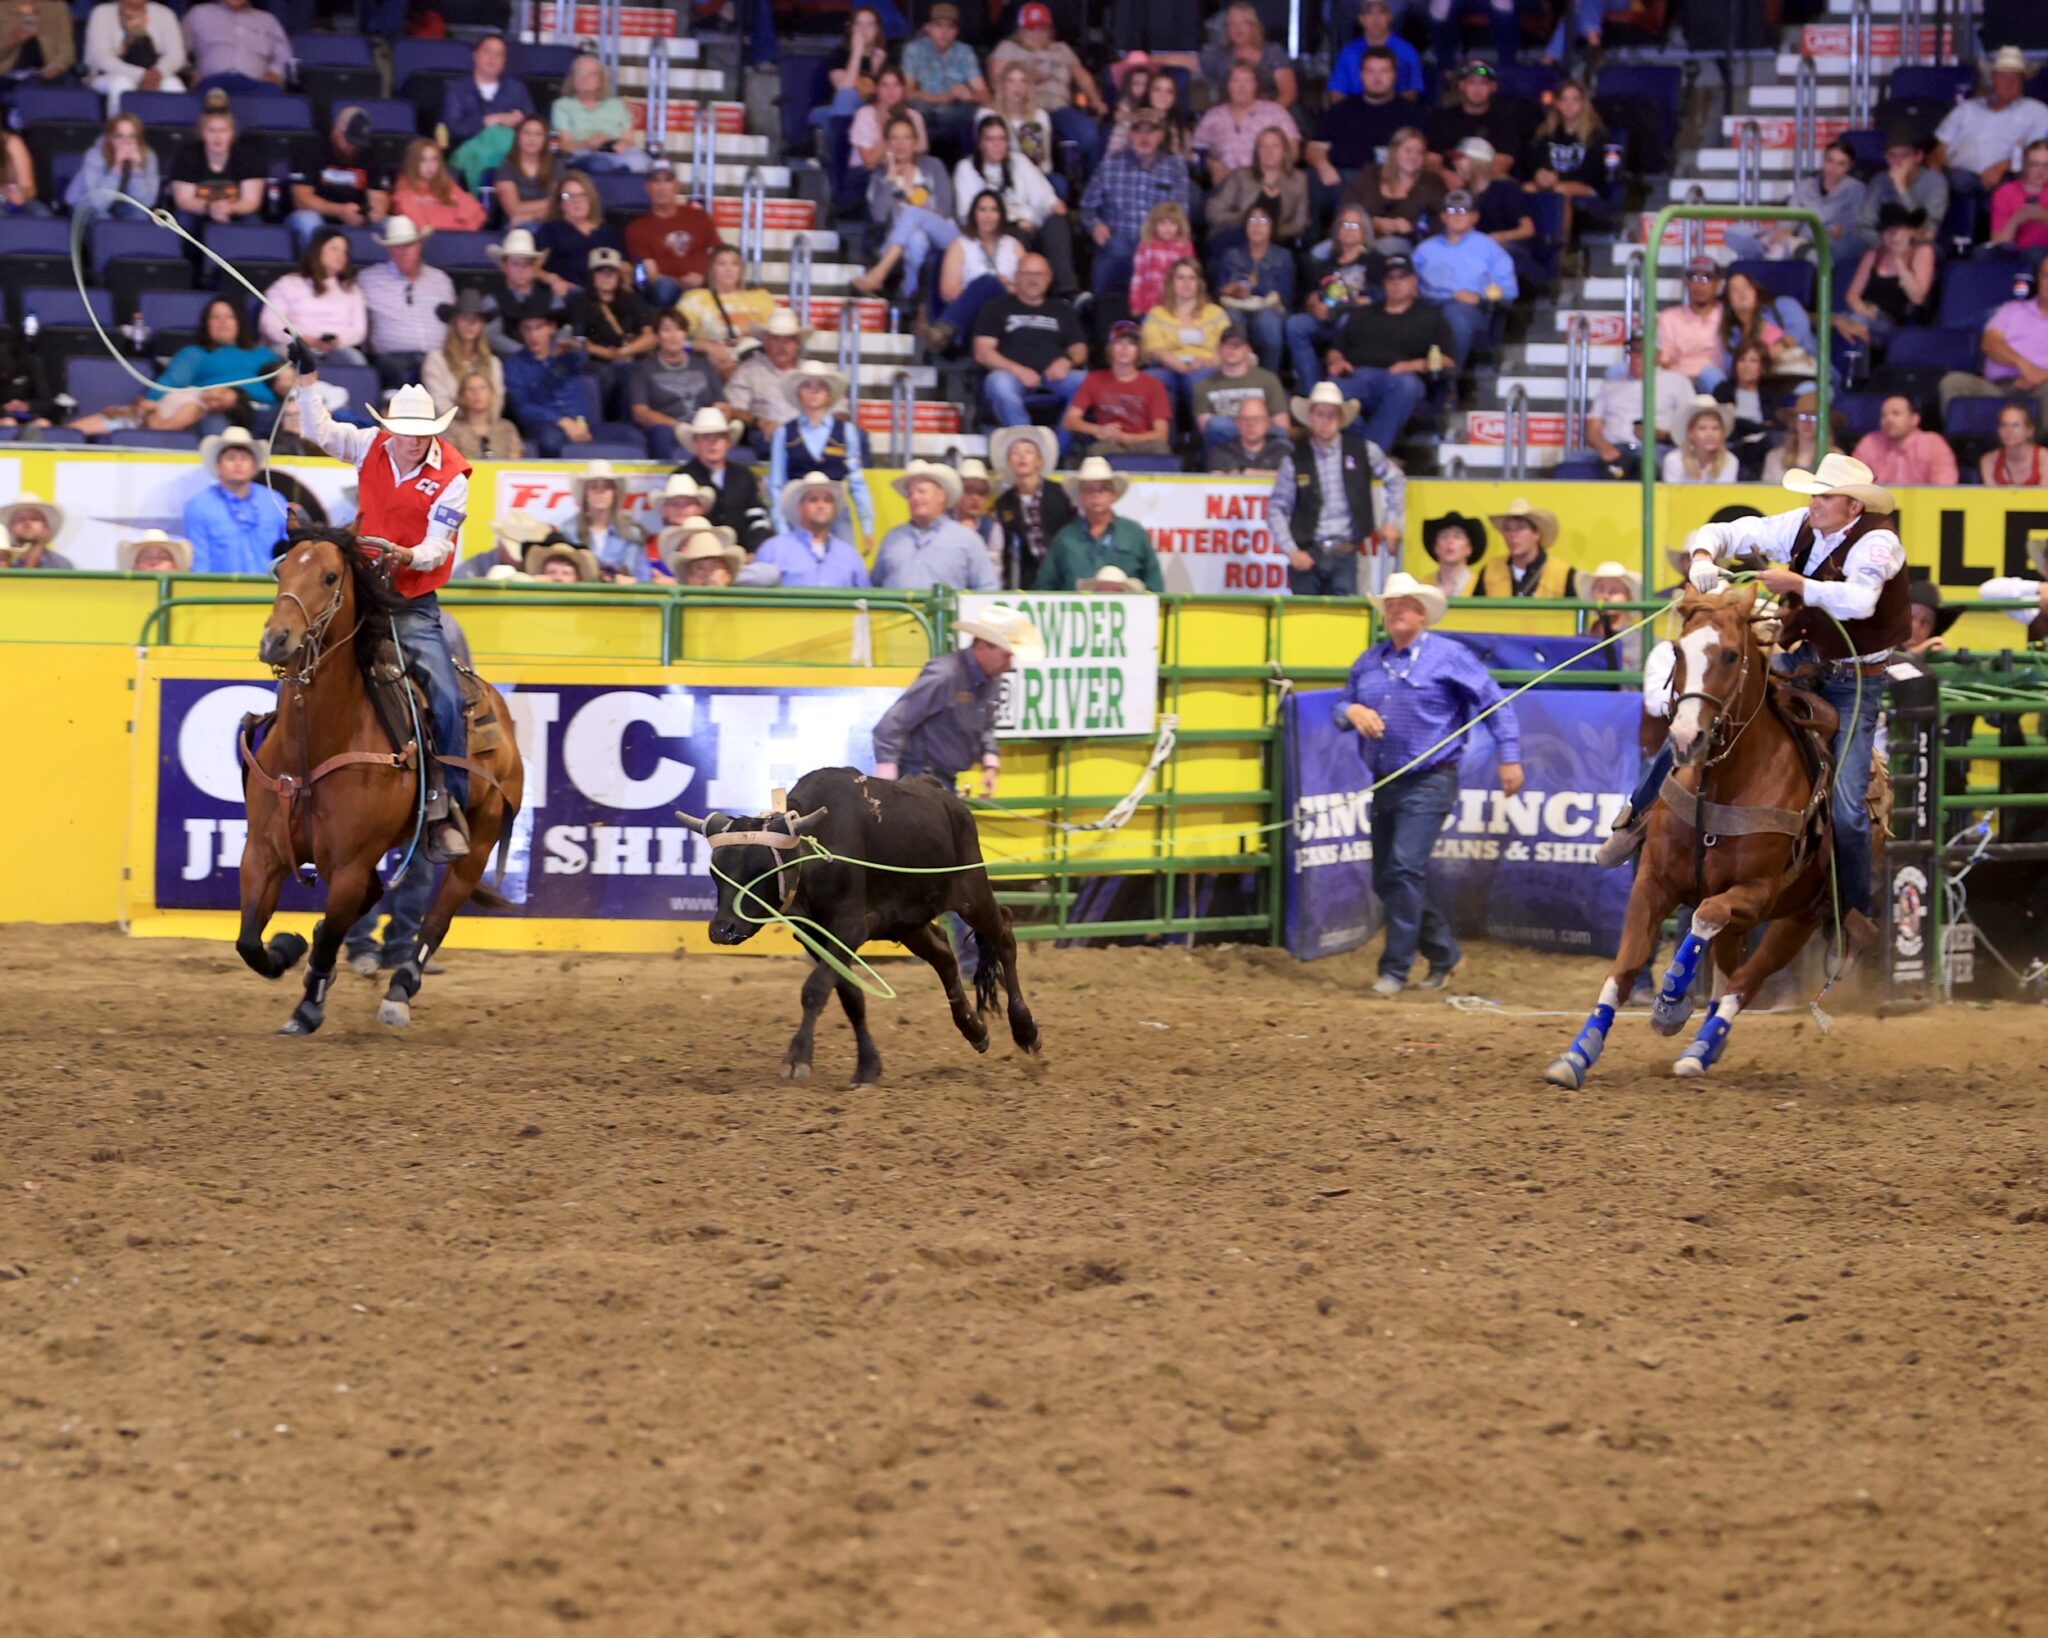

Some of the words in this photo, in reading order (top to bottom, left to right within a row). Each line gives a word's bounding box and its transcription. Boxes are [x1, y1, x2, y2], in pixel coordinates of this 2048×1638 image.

[415, 478, 440, 496] CC
[1206, 494, 1268, 519] NATI
[1225, 561, 1291, 588] ROD
[1022, 667, 1124, 730] RIVER
[543, 825, 713, 876] SHI
[1505, 841, 1530, 861] &
